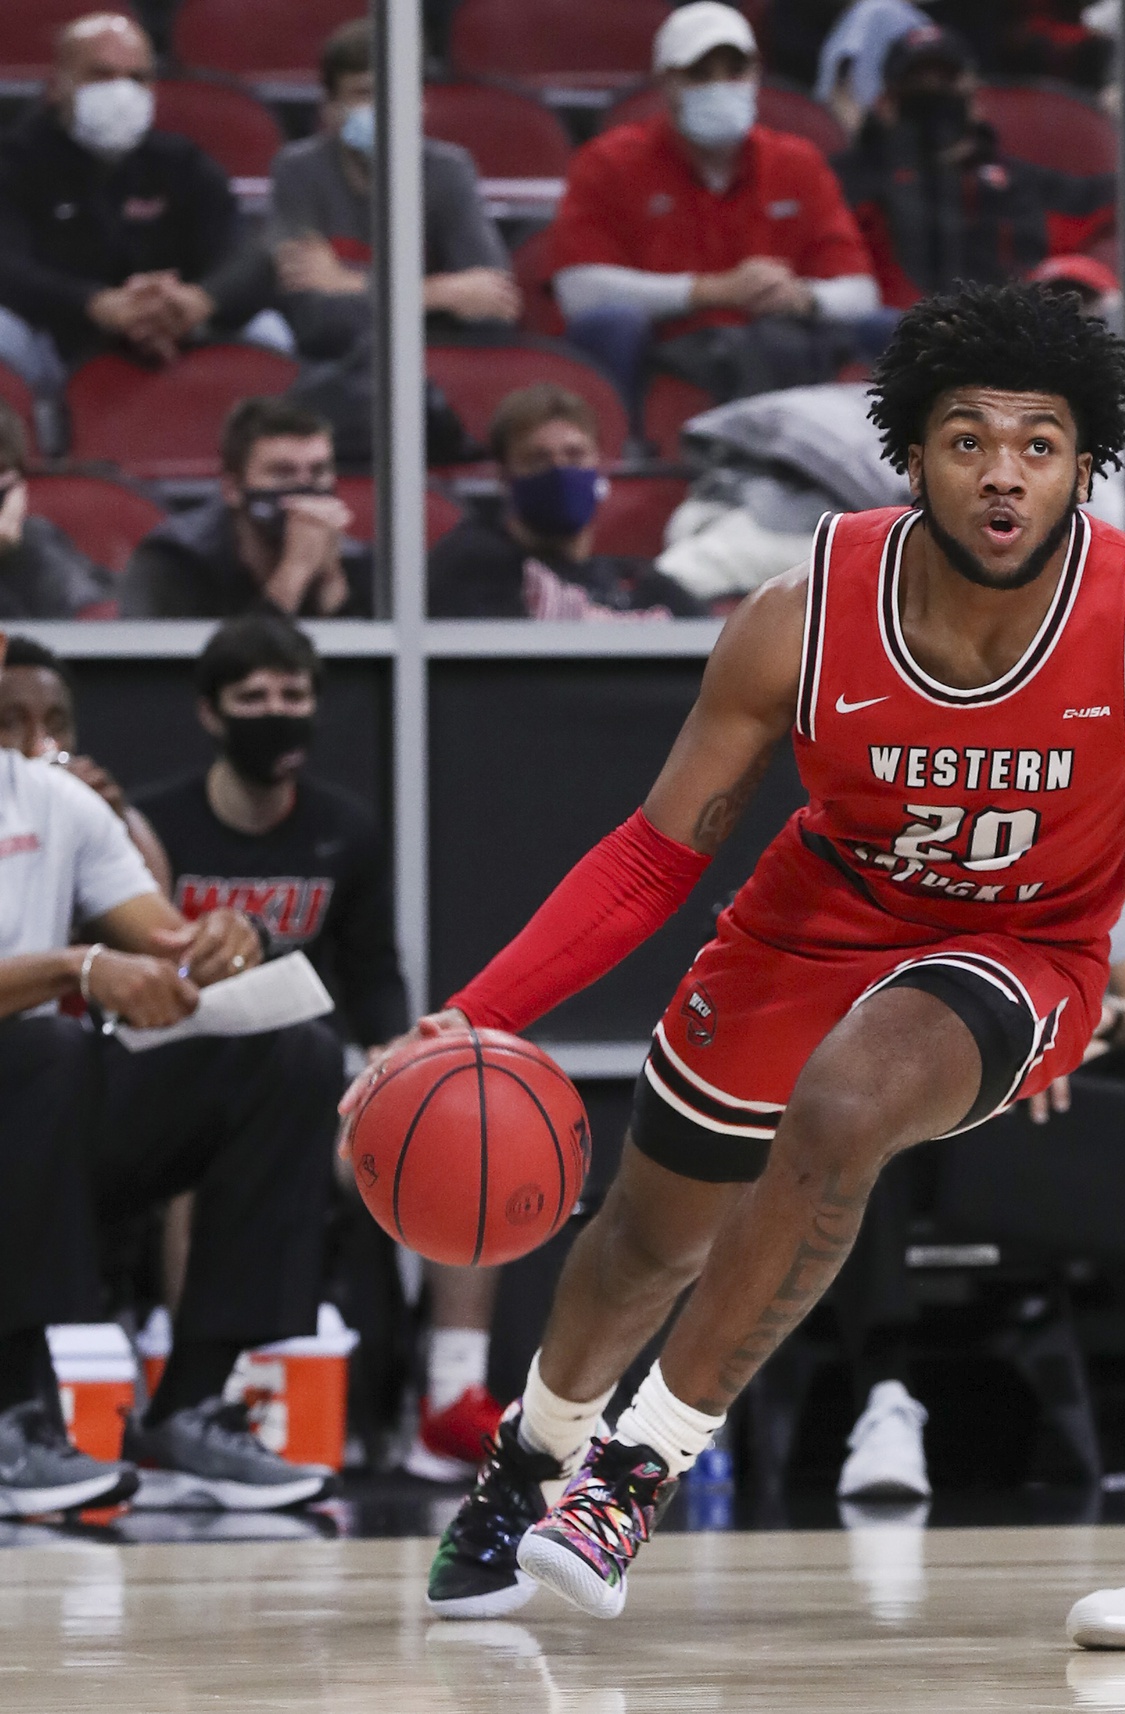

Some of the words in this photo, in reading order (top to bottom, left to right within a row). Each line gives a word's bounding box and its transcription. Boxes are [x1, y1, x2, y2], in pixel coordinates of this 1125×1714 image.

[868, 745, 1075, 792] WESTERN
[894, 803, 1042, 872] 20
[174, 875, 334, 944] WKU
[688, 991, 712, 1018] WKU
